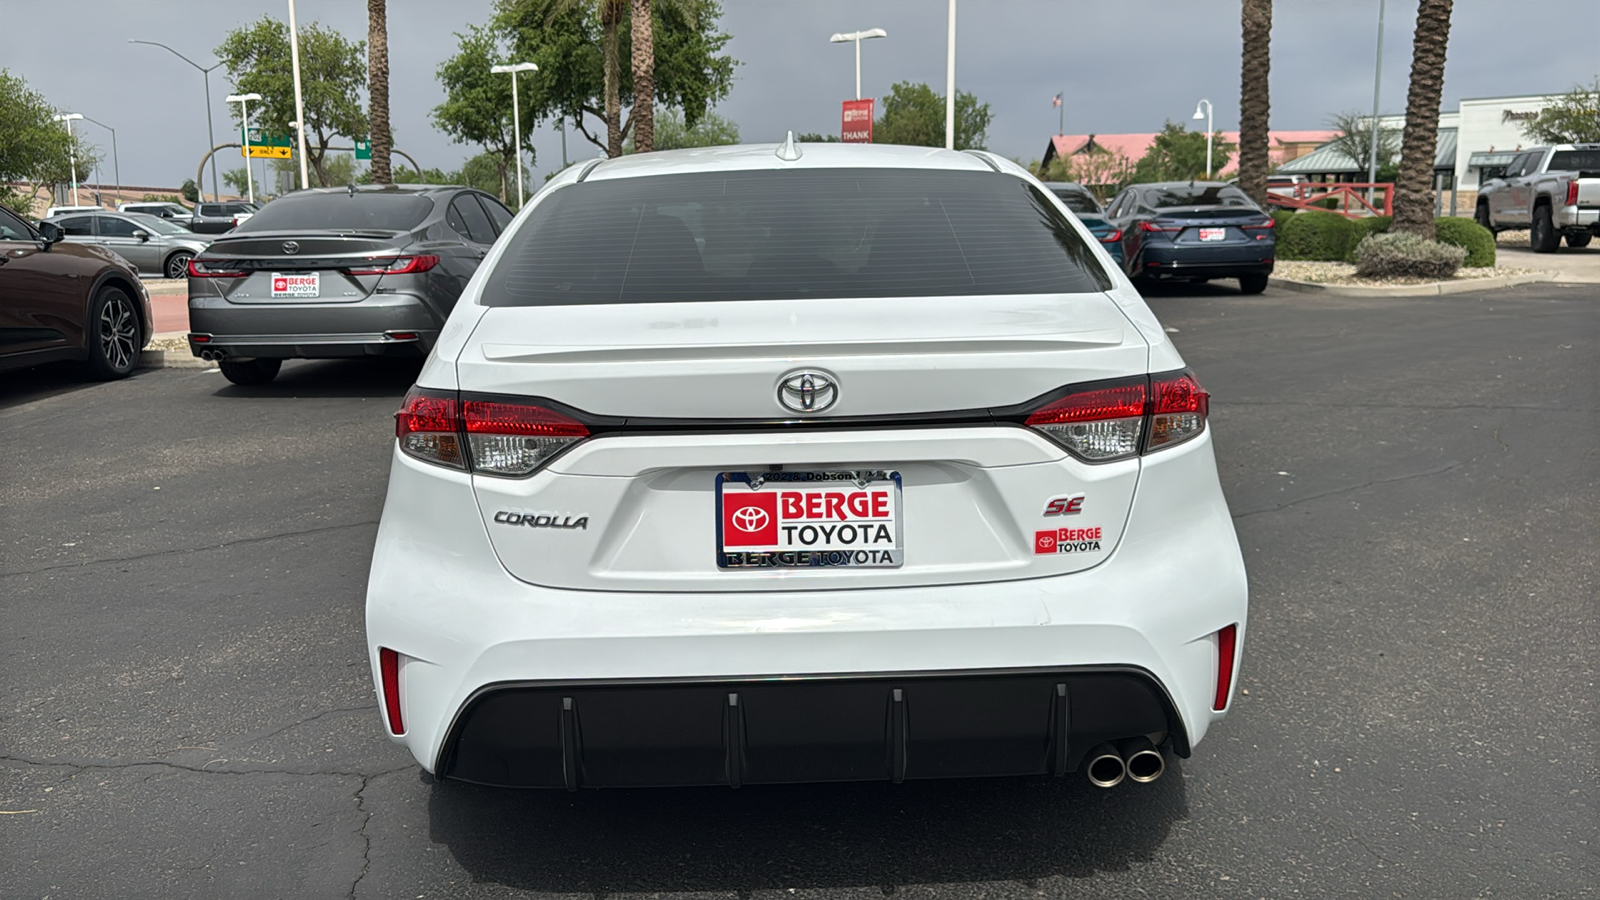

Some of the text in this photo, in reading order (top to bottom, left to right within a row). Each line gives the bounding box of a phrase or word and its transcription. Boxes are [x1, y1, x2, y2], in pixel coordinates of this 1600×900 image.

[843, 131, 869, 140] THANK
[806, 472, 852, 481] Dobson
[781, 491, 890, 521] BERGE
[1043, 495, 1085, 517] SE
[494, 510, 589, 530] COROLLA
[781, 524, 893, 545] TOYOTA
[1058, 527, 1102, 542] BERGE
[1058, 541, 1101, 553] TOYOTA
[726, 551, 811, 567] BERGE
[817, 550, 894, 565] TOYOTA
